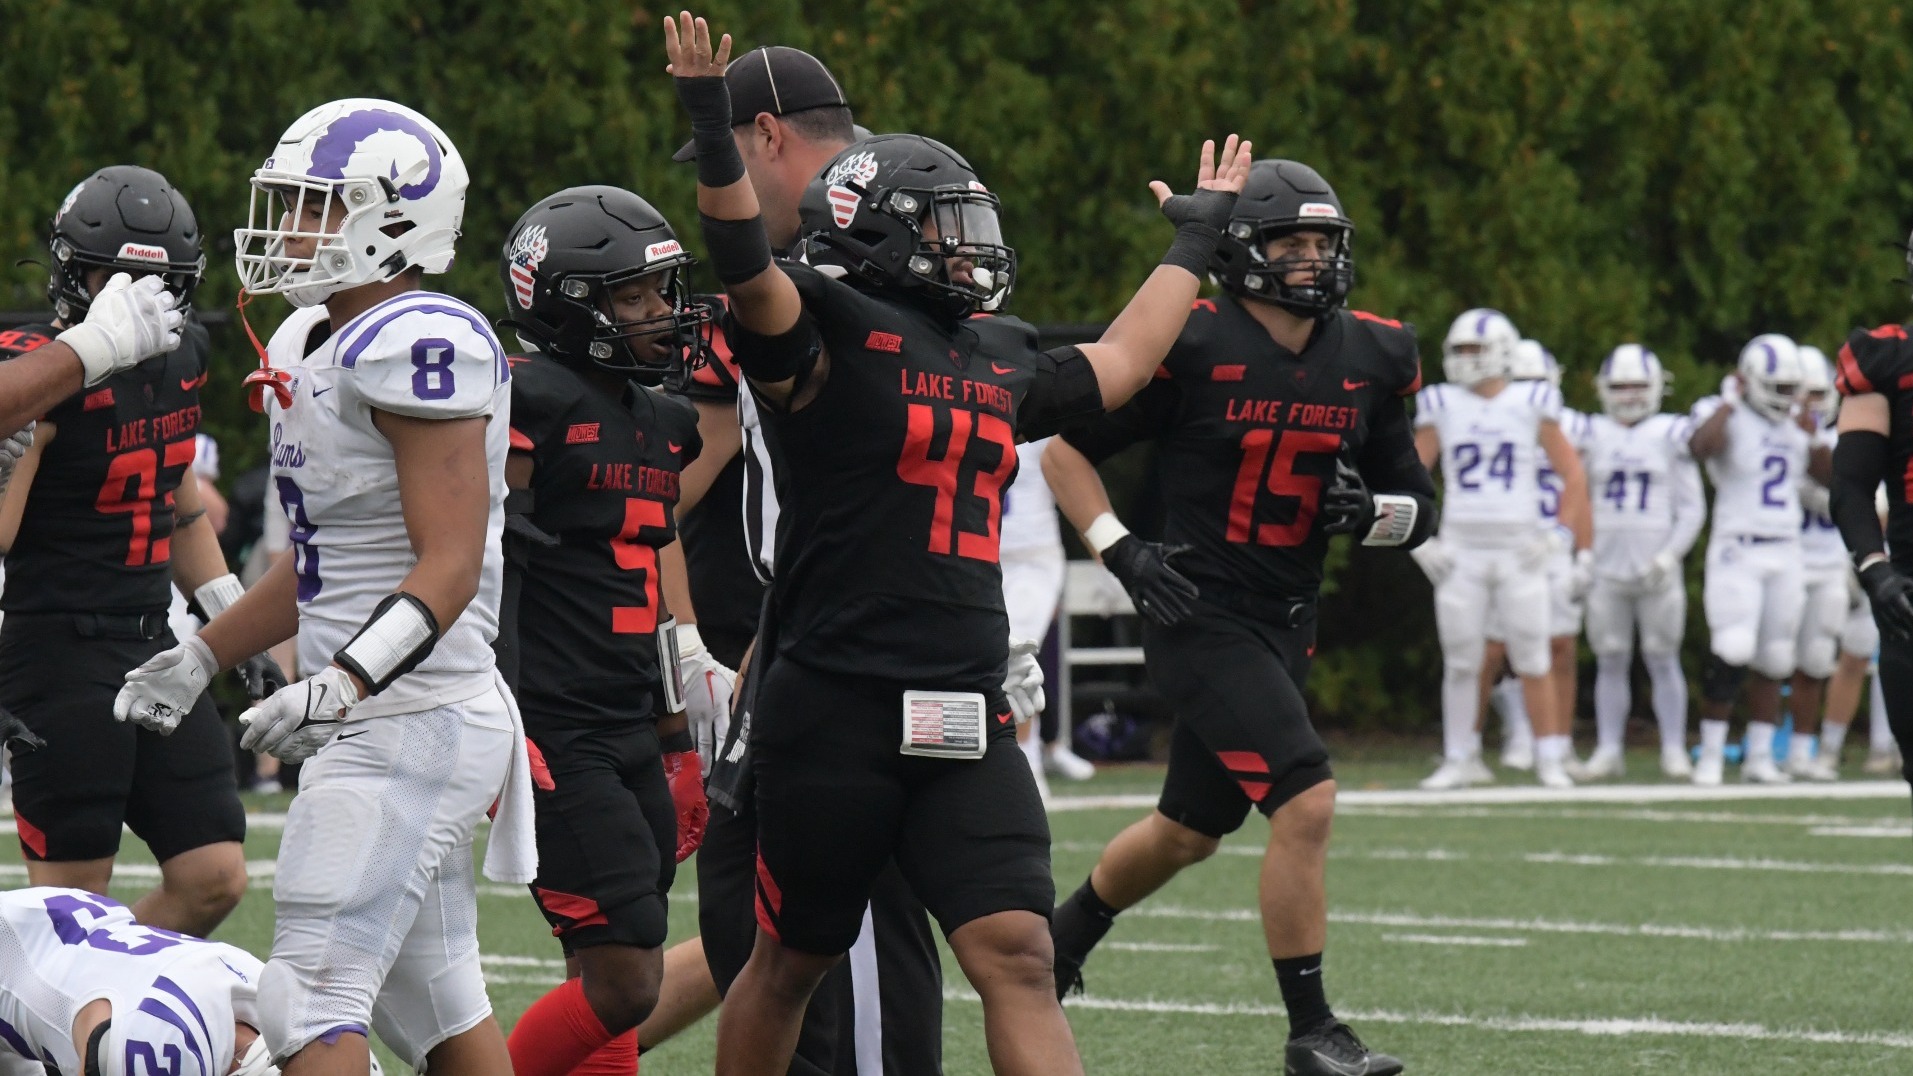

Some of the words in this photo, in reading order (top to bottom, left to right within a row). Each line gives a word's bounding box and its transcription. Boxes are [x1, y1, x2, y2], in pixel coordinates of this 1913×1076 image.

[126, 246, 164, 259] Riddell
[651, 242, 680, 256] Riddell
[411, 338, 455, 400] 8
[901, 368, 955, 400] LAKE
[963, 379, 1014, 415] FOREST
[106, 418, 147, 454] LAKE
[152, 405, 201, 444] FOREST
[1226, 398, 1282, 424] LAKE
[1287, 403, 1360, 430] FOREST
[273, 422, 306, 469] Rams
[1454, 442, 1514, 490] 24
[587, 463, 634, 491] LAKE
[896, 403, 1017, 564] 43
[1226, 428, 1341, 547] 15
[1763, 456, 1787, 507] 2
[275, 475, 323, 603] 8
[609, 497, 667, 633] 5
